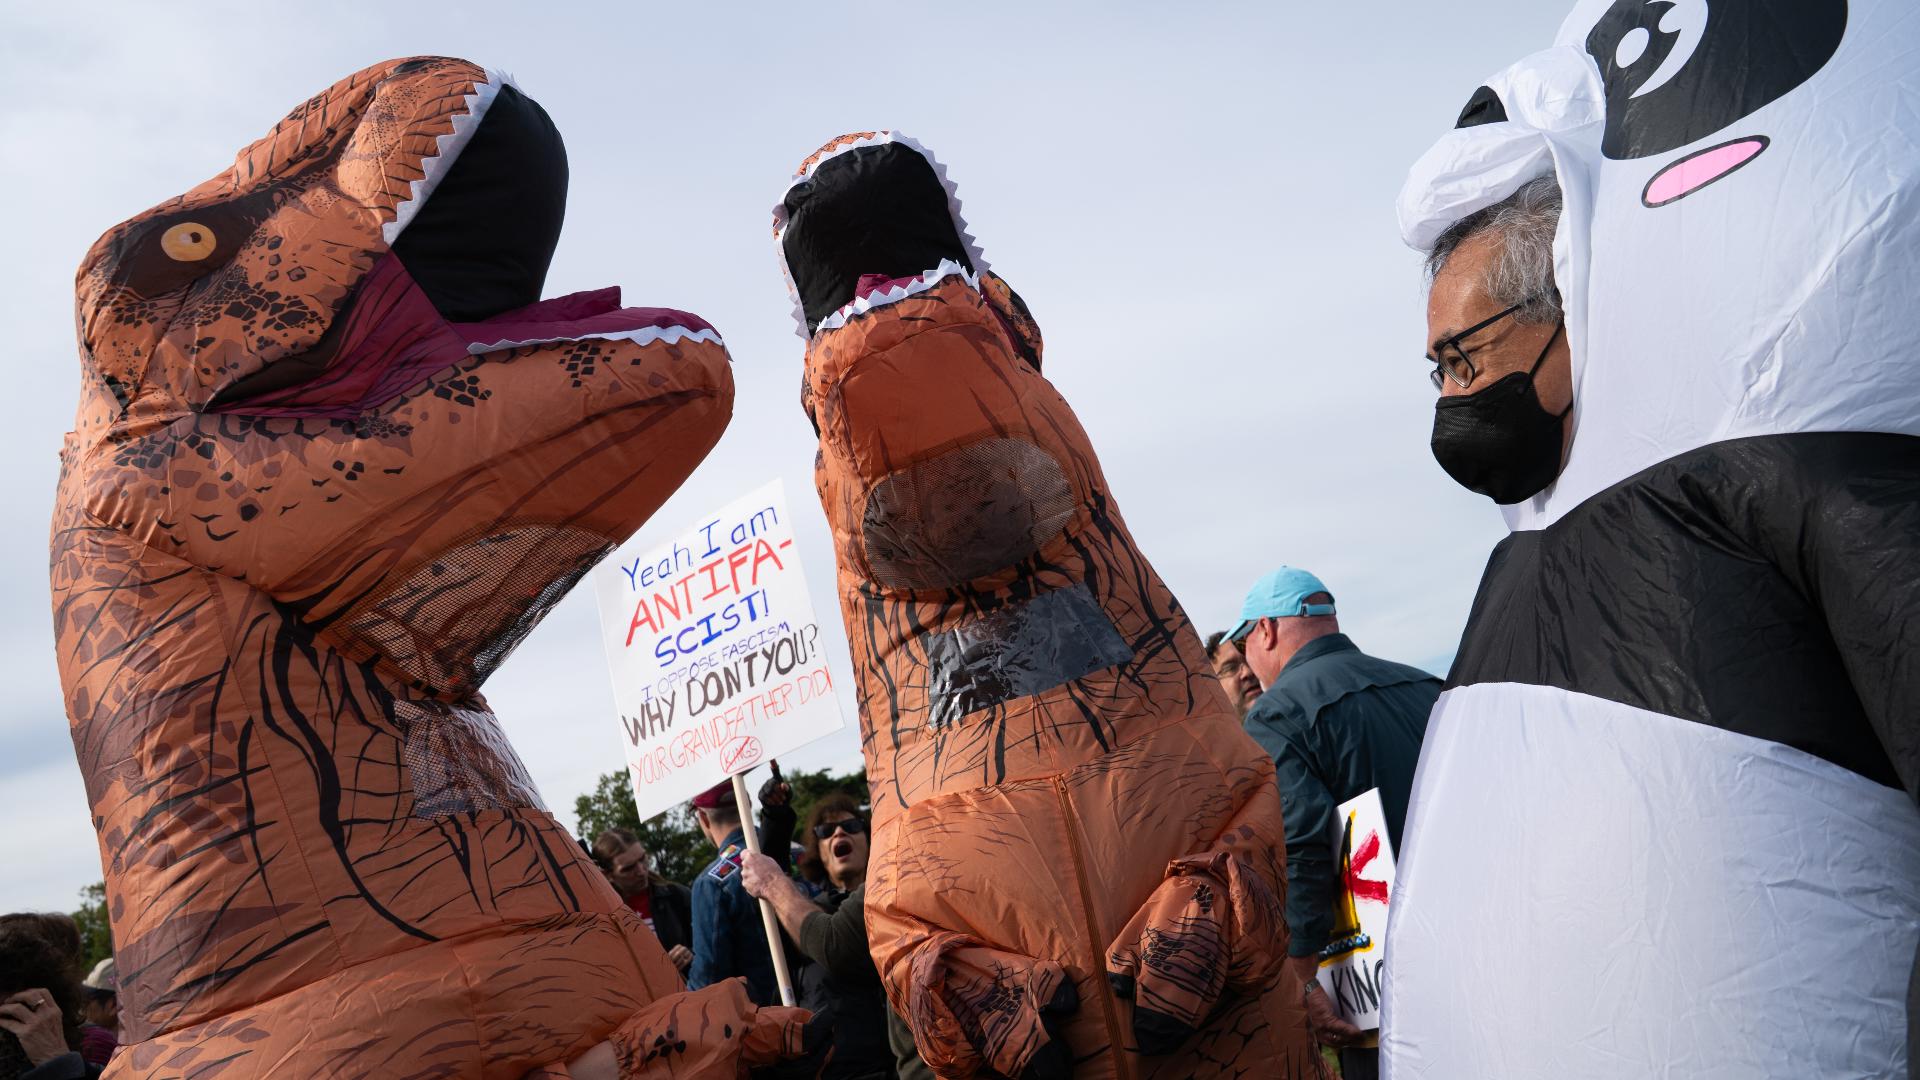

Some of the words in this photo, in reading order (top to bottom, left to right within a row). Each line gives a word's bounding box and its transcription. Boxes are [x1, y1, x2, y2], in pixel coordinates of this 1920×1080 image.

[622, 543, 691, 591] Yeah
[699, 519, 721, 559] I
[731, 507, 778, 545] am
[626, 538, 792, 648] ANTIFA-
[641, 685, 654, 703] I
[657, 652, 720, 695] OPPOSE
[722, 621, 790, 659] FASCISM
[655, 589, 769, 667] SCIST!
[622, 690, 677, 747] WHY
[762, 623, 818, 682] YOU?
[632, 746, 672, 793] YOUR
[669, 683, 793, 768] GRANDFATHER
